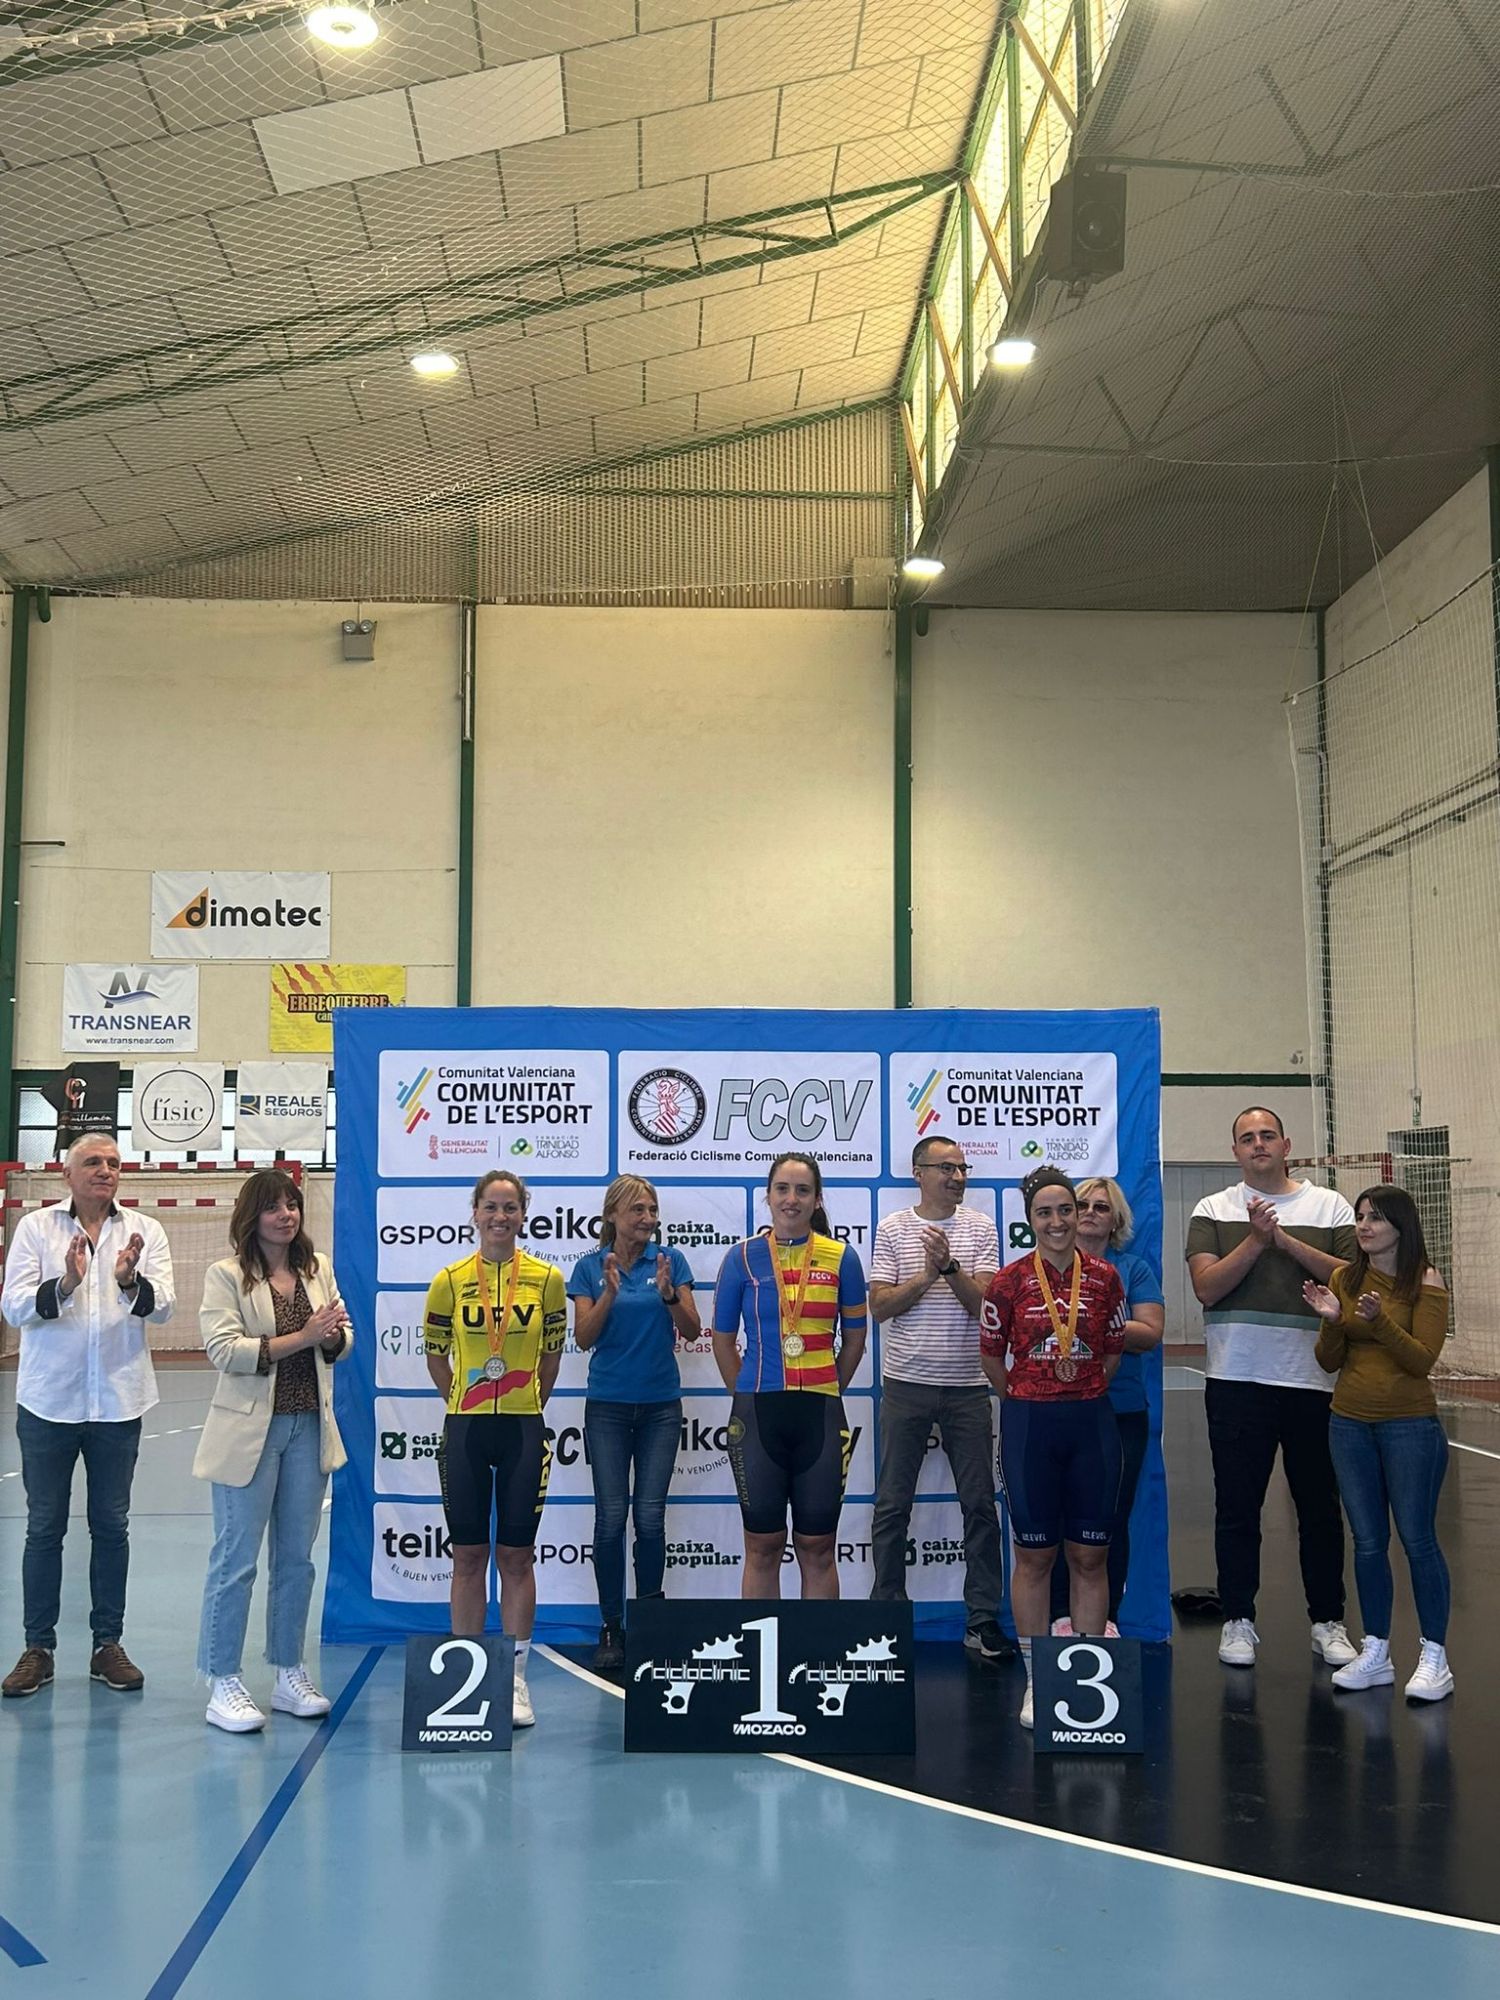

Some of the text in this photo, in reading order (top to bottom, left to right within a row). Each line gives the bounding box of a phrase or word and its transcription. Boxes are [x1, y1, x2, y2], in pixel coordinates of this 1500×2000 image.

[186, 896, 321, 927] dimatec
[69, 1015, 191, 1031] TRANSNEAR
[86, 1035, 174, 1045] www.transnear.com
[438, 1066, 575, 1079] Comunitat Valenciana
[947, 1068, 1083, 1081] Comunitat Valenciana
[437, 1082, 575, 1102] COMUNITAT
[947, 1084, 1083, 1104] COMUNITAT
[265, 1096, 322, 1107] REALE
[151, 1097, 204, 1121] físic
[265, 1107, 322, 1117] SEGUROS
[447, 1105, 478, 1125] DE
[713, 1078, 873, 1142] FCCV
[957, 1107, 987, 1126] DE
[536, 1140, 579, 1149] TRINIDAD
[1046, 1142, 1089, 1151] TRINIDAD
[536, 1149, 579, 1158] ALFONSO
[628, 1150, 687, 1162] Federació
[690, 1150, 741, 1162] Ciclisme
[811, 1151, 873, 1162] Valenciana
[961, 1148, 998, 1156] LENCIANA
[1046, 1151, 1089, 1160] ALFONSO
[667, 1221, 714, 1234] caixa
[380, 1225, 475, 1245] GSPOR
[667, 1232, 740, 1247] popular
[535, 1251, 559, 1263] BUEN
[412, 1433, 443, 1446] cai
[687, 1456, 729, 1475] VENDING
[382, 1525, 453, 1559] teik
[666, 1540, 714, 1553] caixa
[666, 1553, 741, 1568] popular
[402, 1570, 428, 1582] BUEN
[741, 1616, 797, 1722] 1
[426, 1639, 490, 1727] 2
[1054, 1643, 1119, 1730] 3
[733, 1723, 806, 1736] MOZACO
[419, 1730, 493, 1743] MOZACO
[1052, 1730, 1126, 1744] MOZACO
